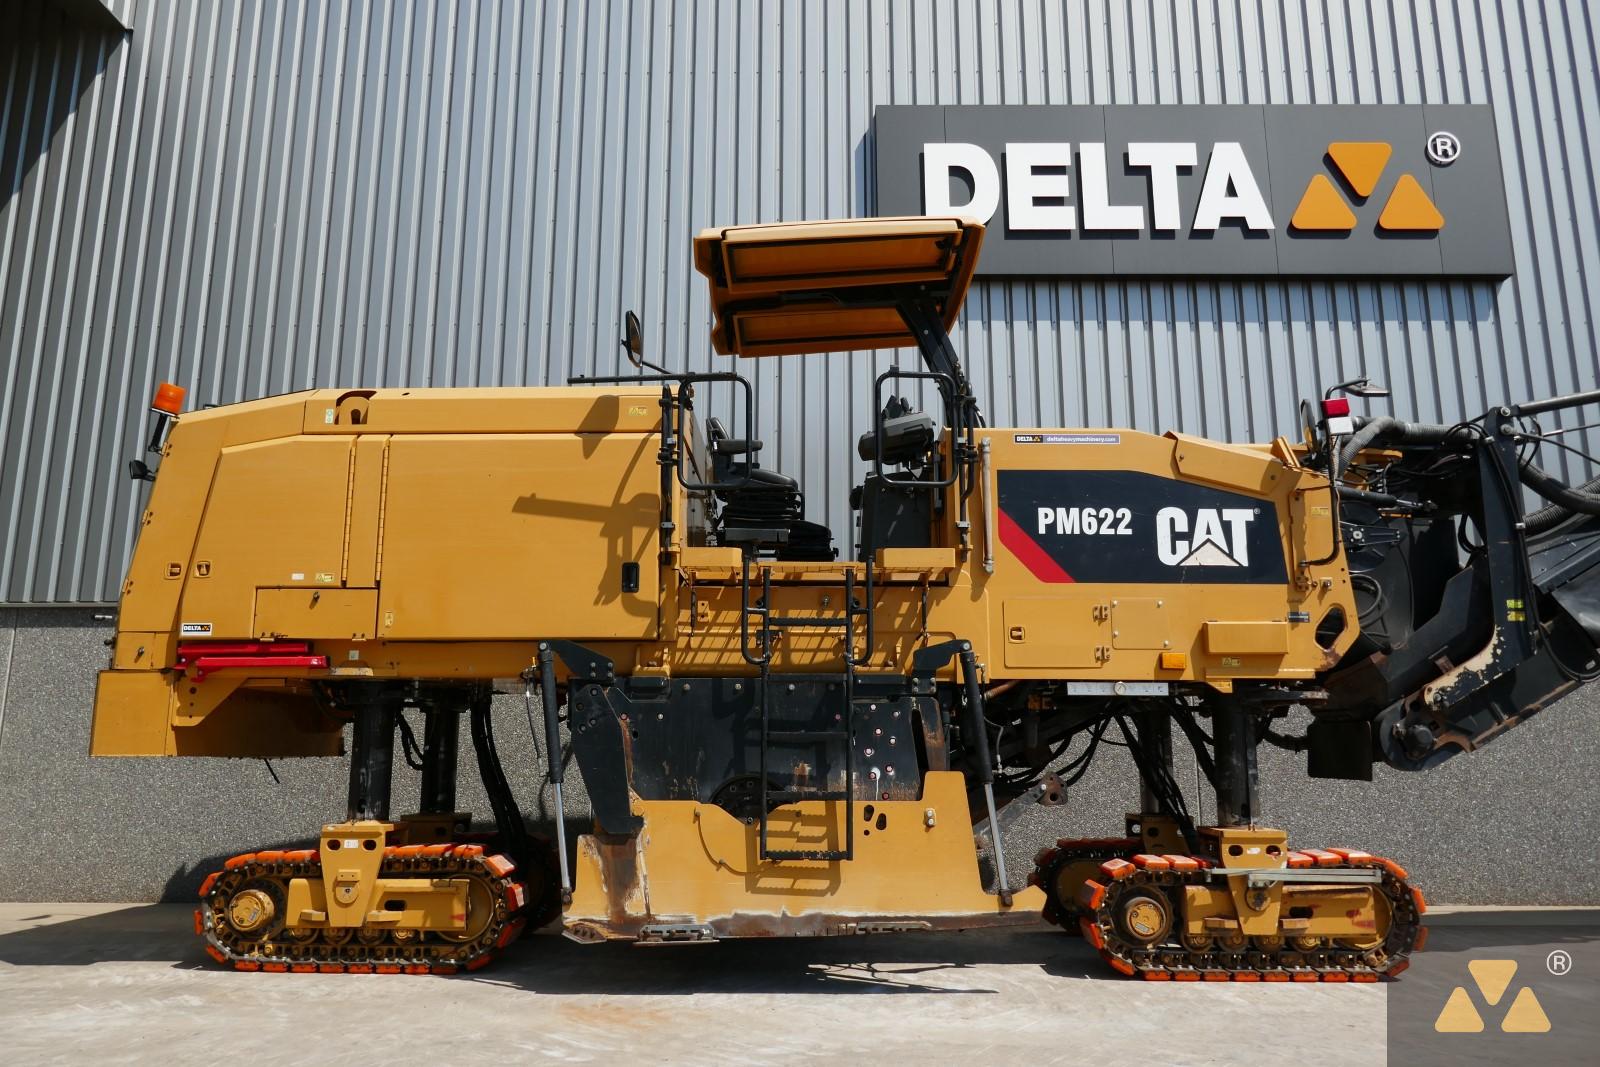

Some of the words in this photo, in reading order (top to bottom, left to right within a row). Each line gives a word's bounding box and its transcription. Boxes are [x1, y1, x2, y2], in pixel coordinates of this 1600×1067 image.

[923, 142, 1275, 230] DELTA
[1037, 507, 1133, 535] PM622
[1156, 506, 1255, 567] CAT
